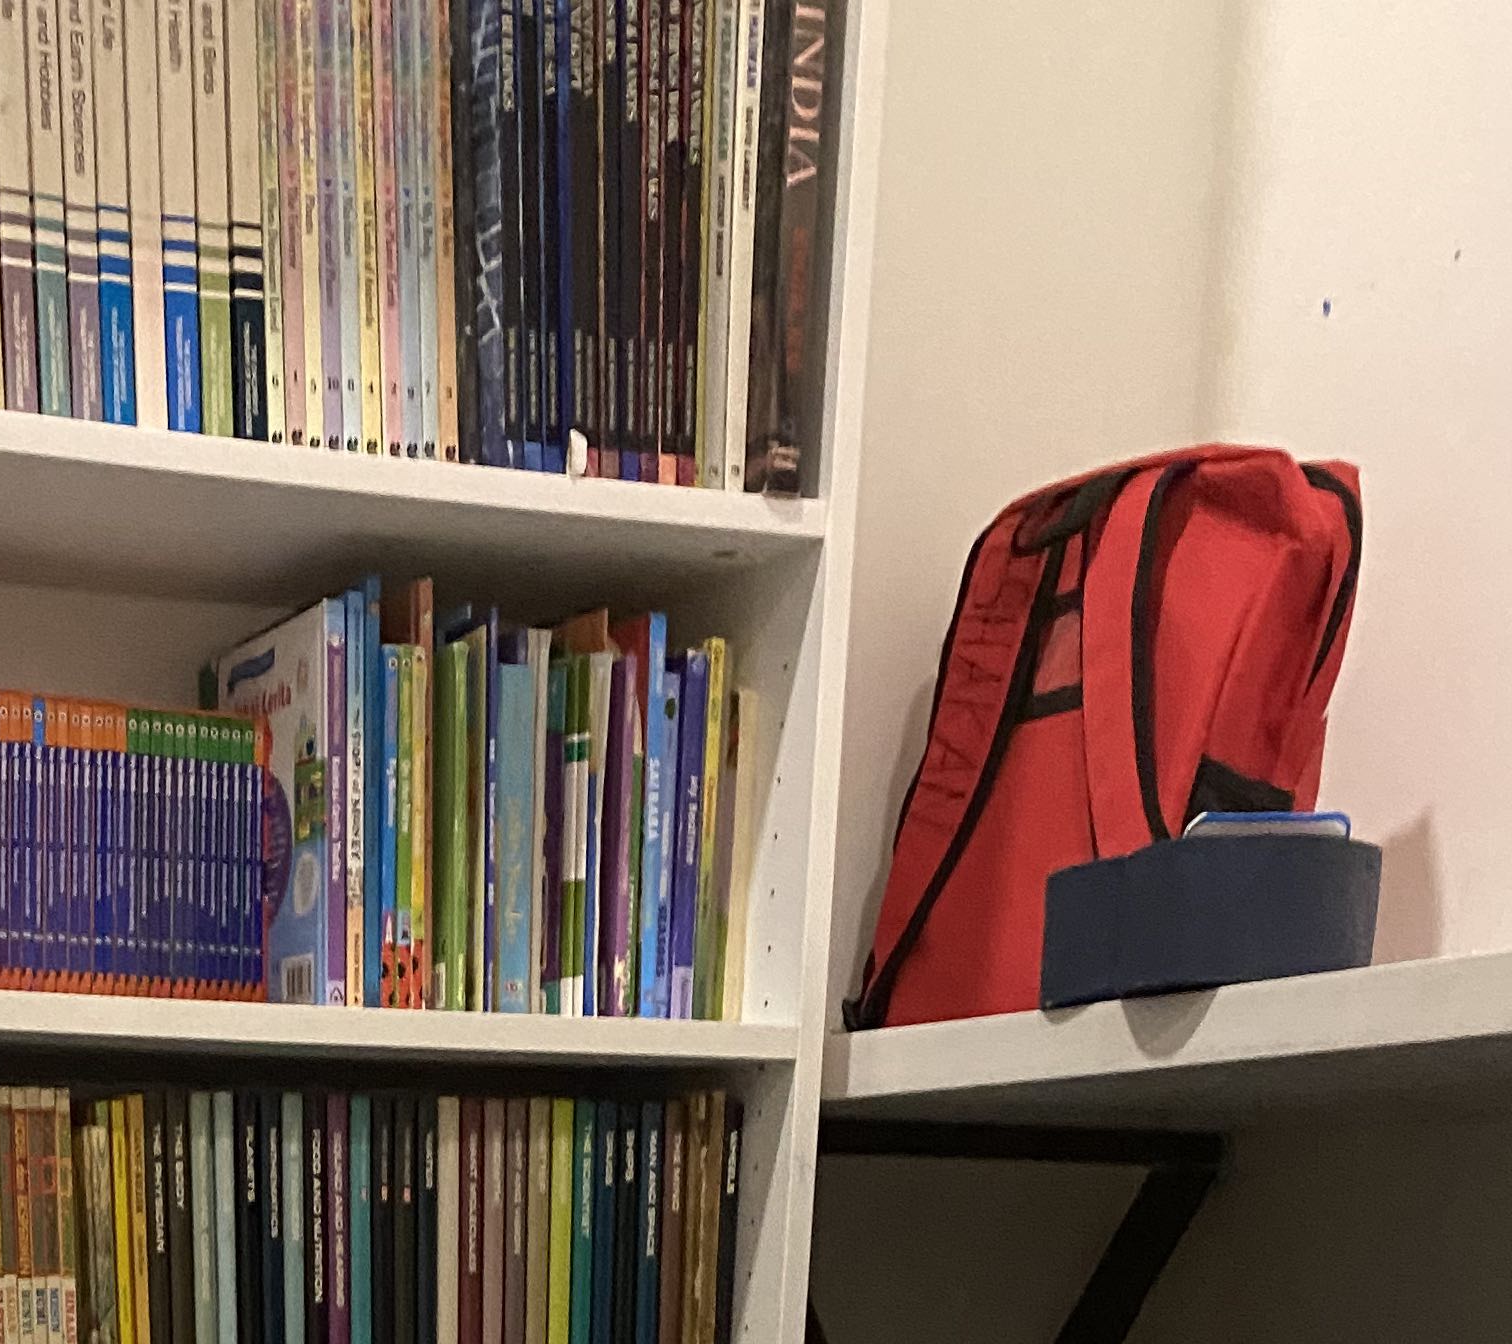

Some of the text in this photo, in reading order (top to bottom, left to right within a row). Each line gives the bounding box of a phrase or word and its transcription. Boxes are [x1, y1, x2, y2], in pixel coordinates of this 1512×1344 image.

[37, 6, 52, 131] and Hobbies
[102, 15, 114, 51] Life
[202, 3, 216, 94] and Birds
[70, 30, 86, 176] Earth Sciences
[786, 2, 826, 188] INDIA
[648, 792, 660, 841] BABA
[152, 1123, 165, 1253] THE PHYSICIAN
[174, 1123, 185, 1209] THE BODY
[313, 1128, 323, 1303] FOOD AND NUTRITION
[646, 1169, 657, 1257] AND SPACE
